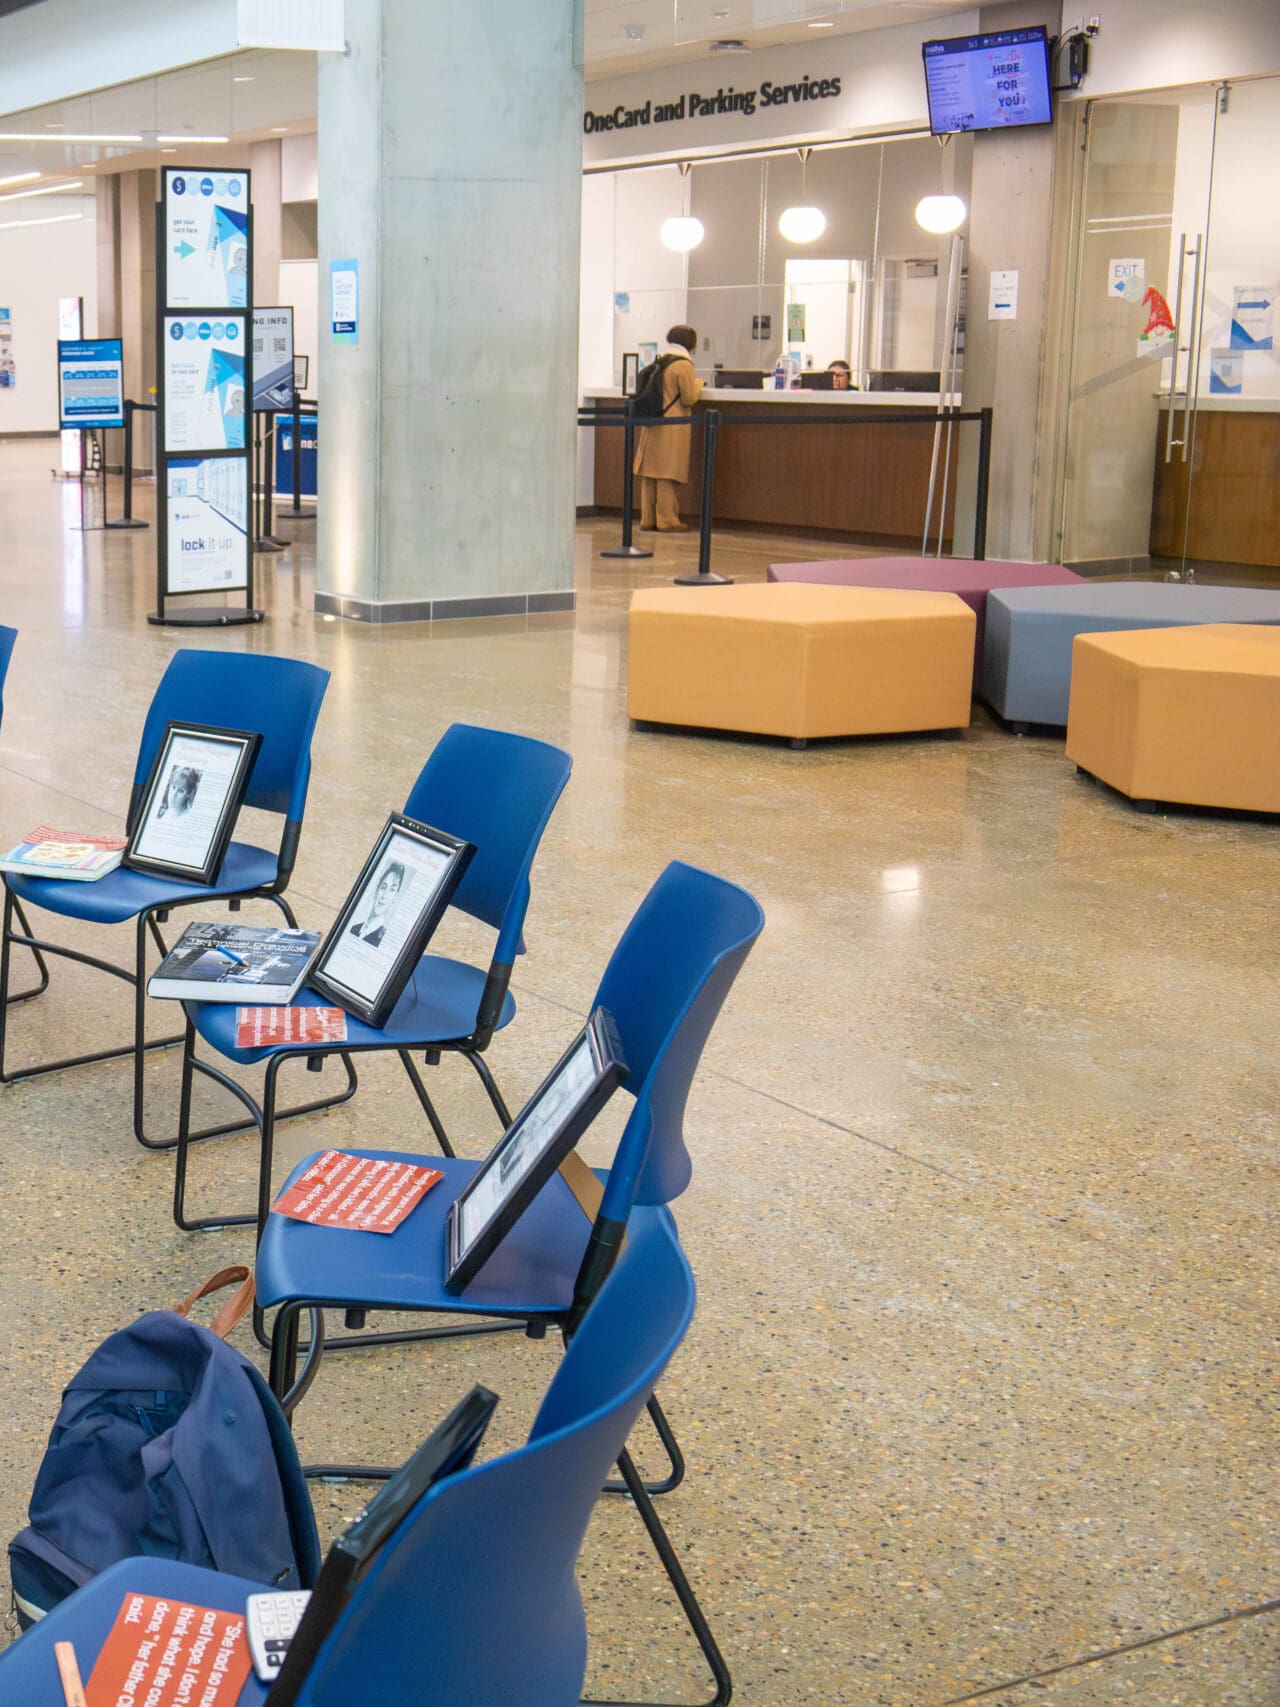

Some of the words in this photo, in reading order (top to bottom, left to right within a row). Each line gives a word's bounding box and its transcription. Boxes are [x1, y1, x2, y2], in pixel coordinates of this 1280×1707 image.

[993, 62, 1020, 75] HERE
[997, 79, 1018, 91] FOR
[584, 101, 651, 134] OneCard
[654, 95, 684, 123] and
[689, 87, 757, 116] Parking
[760, 75, 842, 107] Services
[1114, 264, 1138, 278] EXIT
[267, 317, 288, 325] INFO
[181, 538, 205, 551] lock
[208, 538, 216, 550] it
[218, 539, 232, 552] up
[124, 1596, 144, 1624] said.
[172, 1607, 195, 1635] think
[199, 1611, 217, 1636] and
[137, 1640, 157, 1660] her
[160, 1637, 182, 1666] what
[187, 1634, 213, 1666] hope.
[213, 1647, 235, 1672] had
[122, 1660, 149, 1695] father
[152, 1666, 172, 1688] she
[208, 1670, 223, 1686] so
[143, 1687, 163, 1707] cou
[173, 1673, 197, 1704] don't
[199, 1685, 218, 1707] mu
